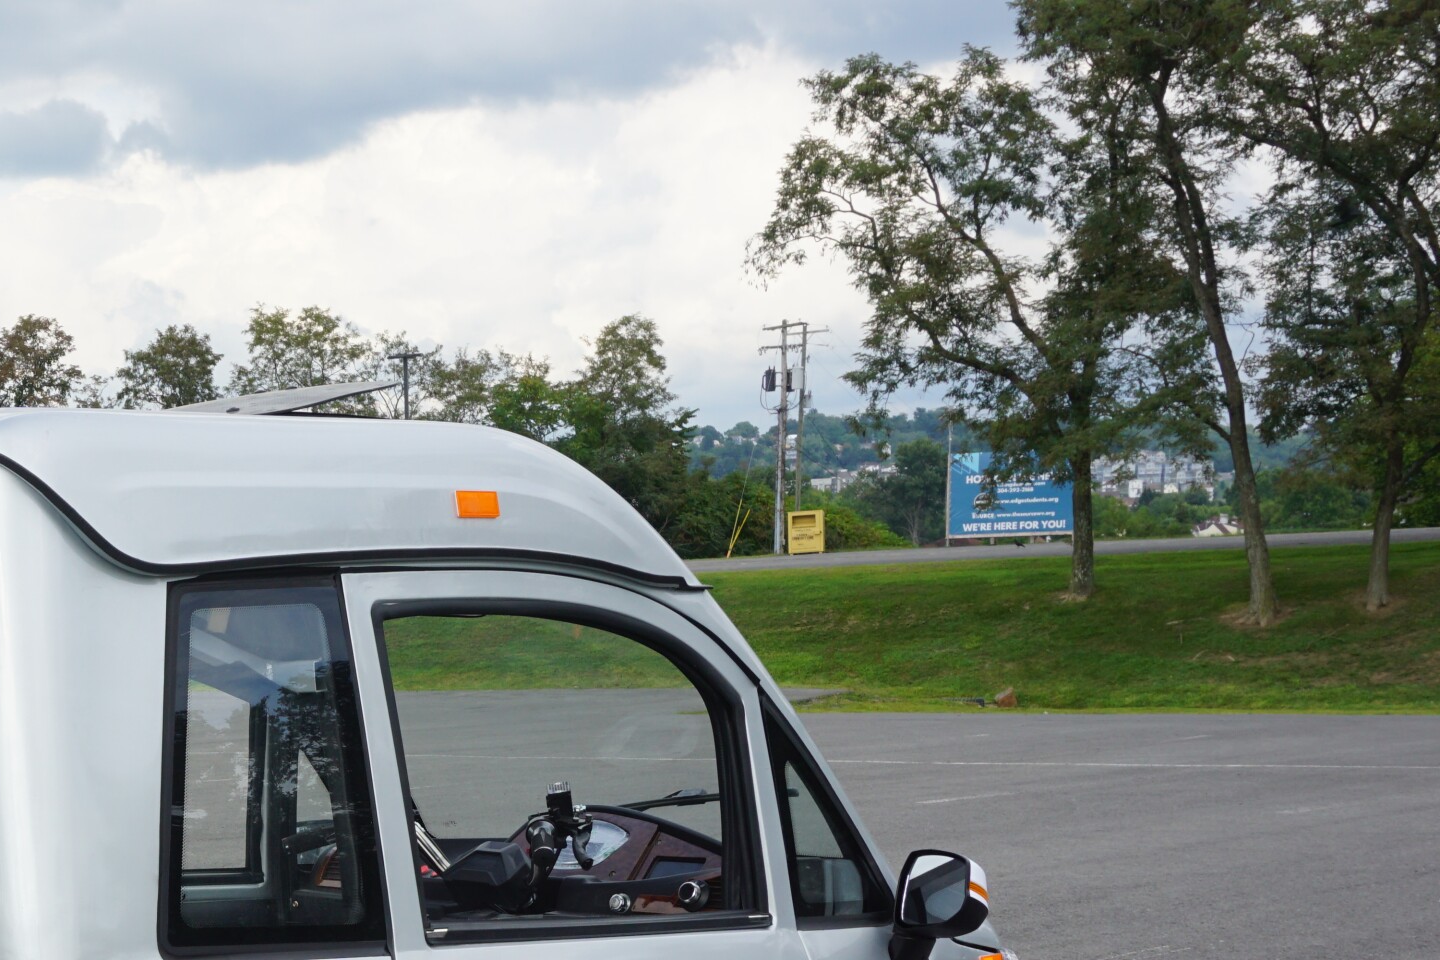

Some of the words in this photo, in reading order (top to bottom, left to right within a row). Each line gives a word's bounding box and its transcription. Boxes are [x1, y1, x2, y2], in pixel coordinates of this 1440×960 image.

[963, 522, 992, 532] WE'RE
[994, 521, 1018, 531] HERE
[1019, 520, 1039, 530] FOR
[1041, 519, 1066, 529] YOU!
